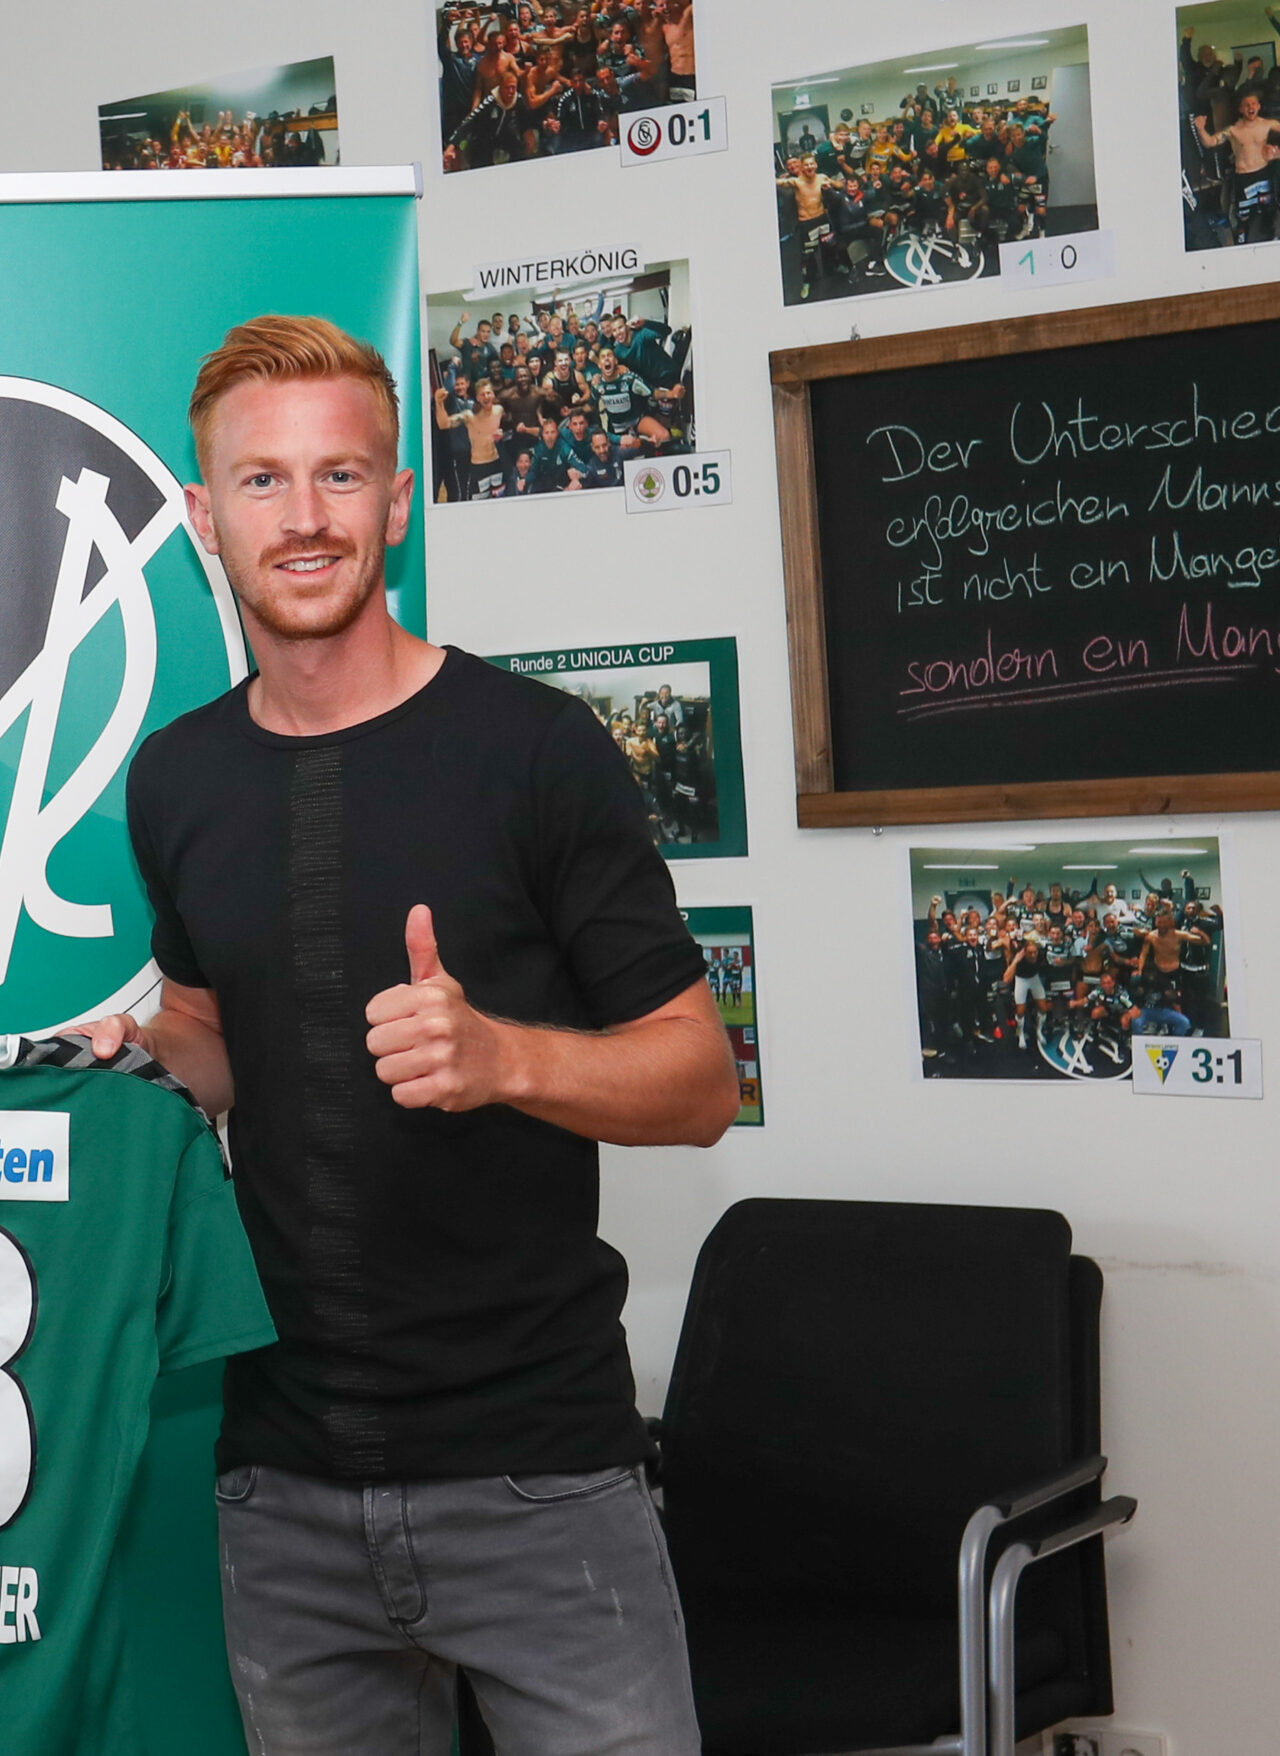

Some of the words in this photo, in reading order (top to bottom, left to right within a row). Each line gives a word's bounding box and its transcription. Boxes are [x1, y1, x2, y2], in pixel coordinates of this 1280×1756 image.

[668, 109, 711, 146] 0:1
[479, 249, 638, 289] WINTERKÖNIG
[866, 424, 983, 482] Der
[672, 463, 720, 497] 0:5
[886, 479, 1129, 571] erfolgreichen
[963, 552, 1052, 601] nicht
[1070, 560, 1130, 589] ein
[510, 657, 553, 673] Runde
[557, 654, 567, 669] 2
[570, 648, 634, 668] UNIQUA
[638, 645, 675, 663] CUP
[899, 626, 1057, 696] sondern
[1083, 635, 1148, 672] ein
[1176, 602, 1280, 675] Man
[1191, 1047, 1243, 1084] 3:1
